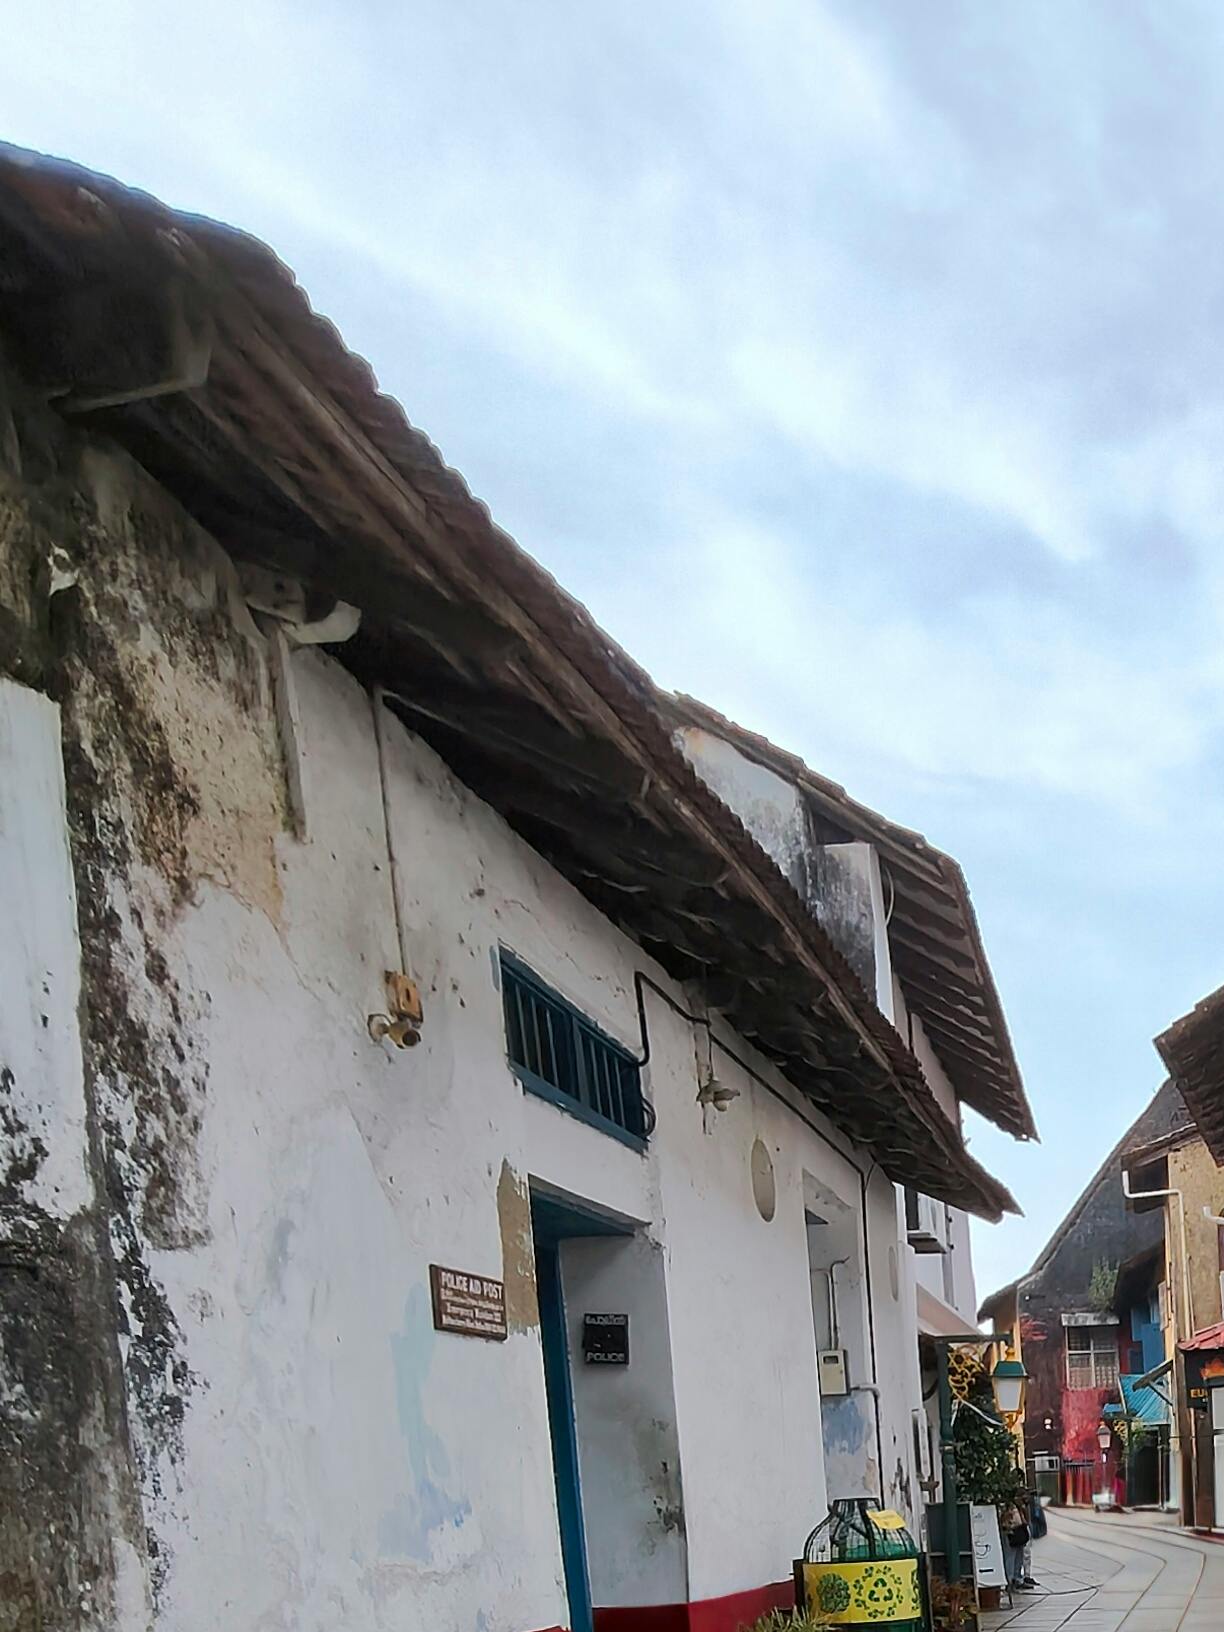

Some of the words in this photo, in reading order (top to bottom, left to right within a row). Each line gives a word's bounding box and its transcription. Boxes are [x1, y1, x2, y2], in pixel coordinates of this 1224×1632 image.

[441, 1271, 468, 1291] POLICE
[469, 1278, 482, 1295] AID
[483, 1281, 503, 1300] POST
[586, 1352, 625, 1362] POLICE
